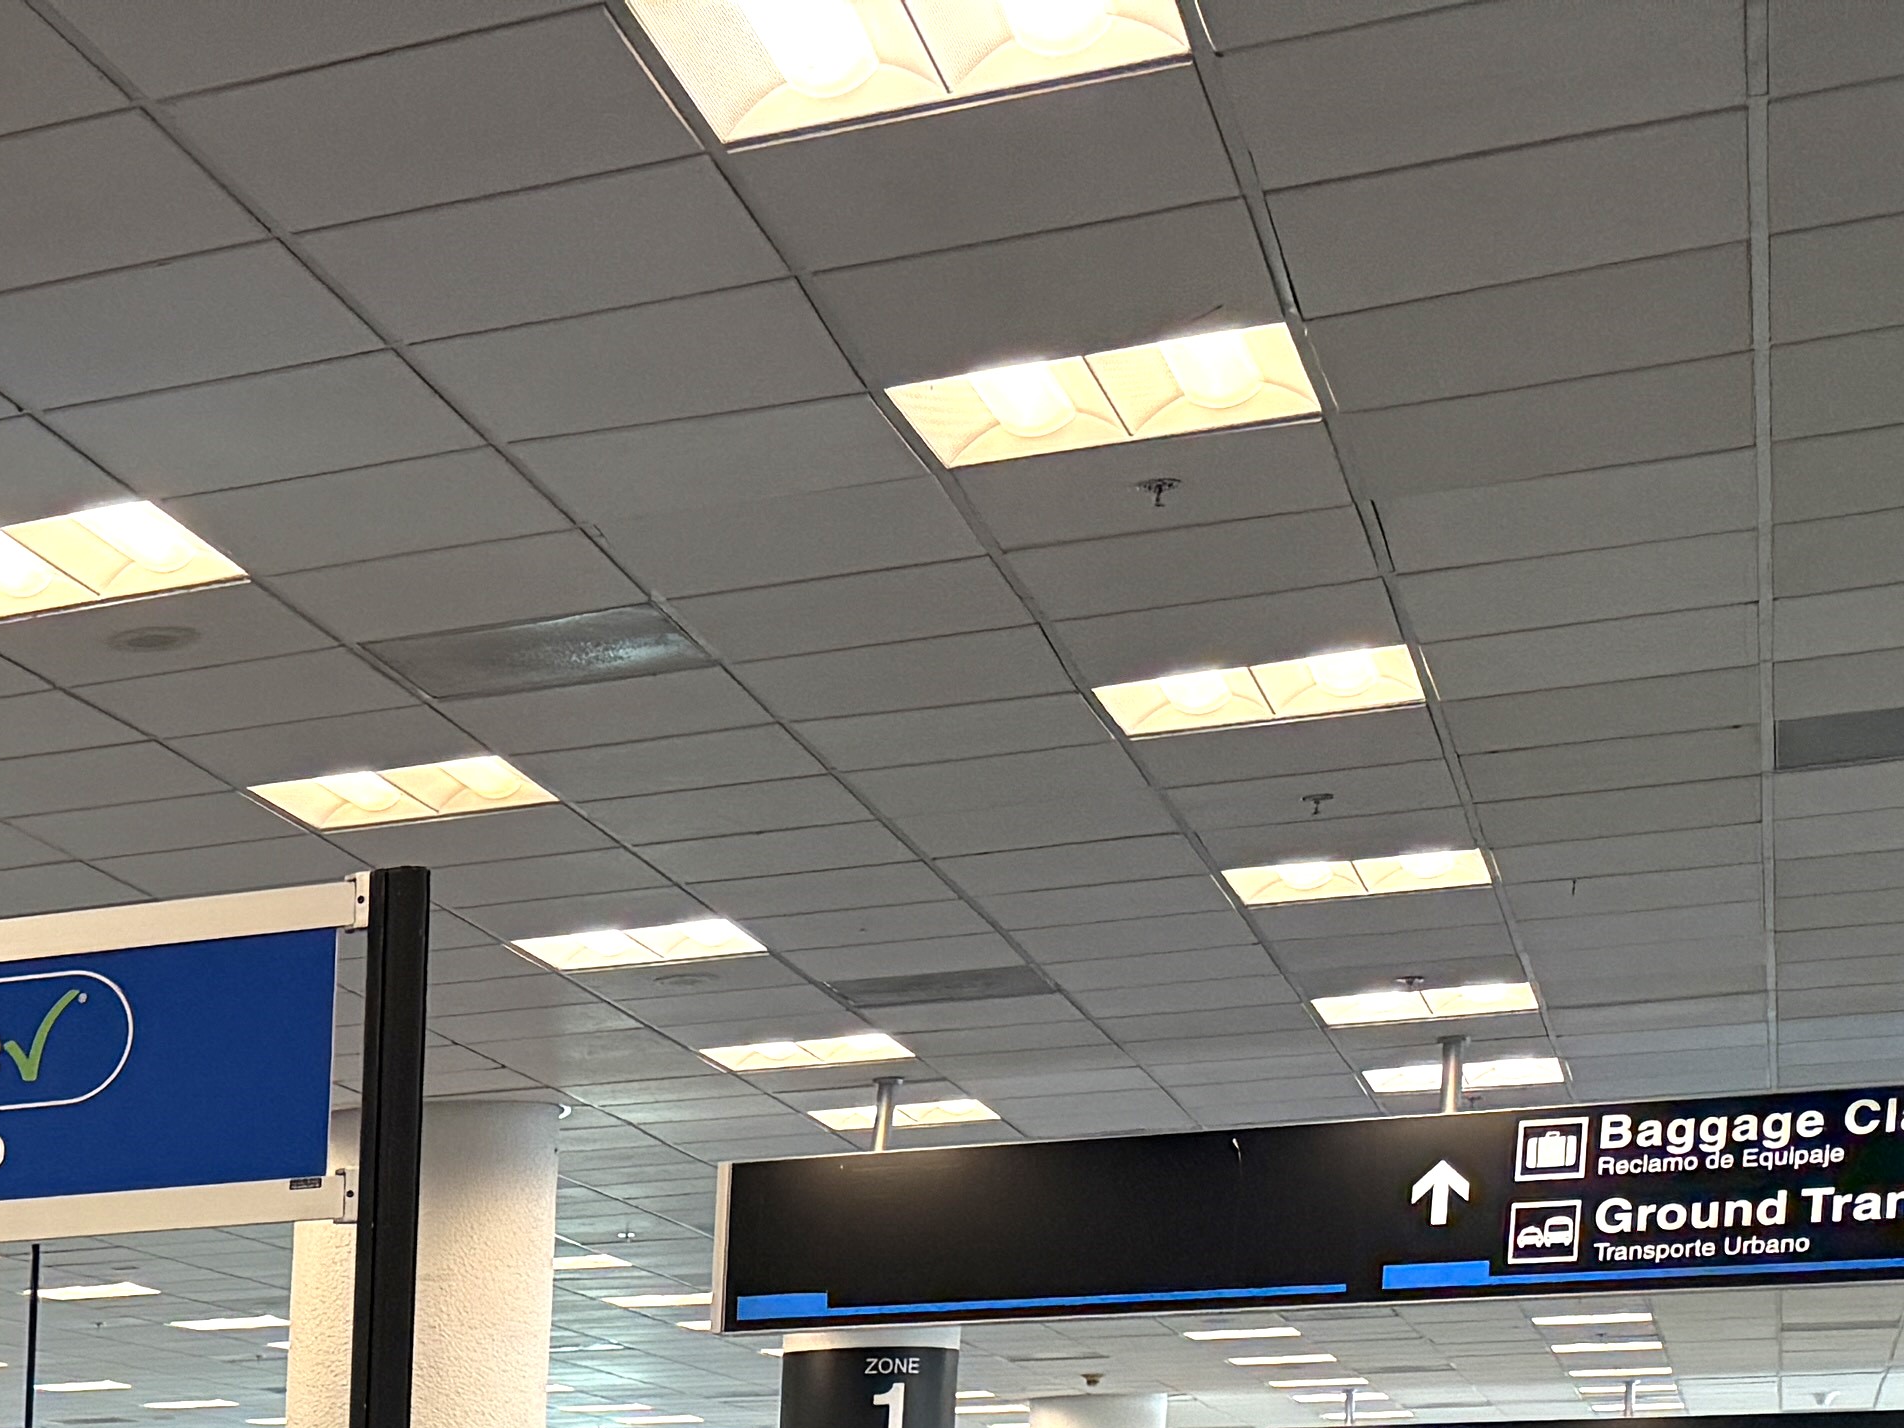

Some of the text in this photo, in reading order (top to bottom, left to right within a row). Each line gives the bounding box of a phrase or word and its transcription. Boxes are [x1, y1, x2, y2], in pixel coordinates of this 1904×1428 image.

[1599, 1108, 1825, 1155] Baggage
[1597, 1144, 1845, 1175] Reclamo de Equipaje
[1595, 1189, 1788, 1233] Ground
[1594, 1235, 1811, 1263] Transporte Urbano
[864, 1358, 920, 1374] ZONE
